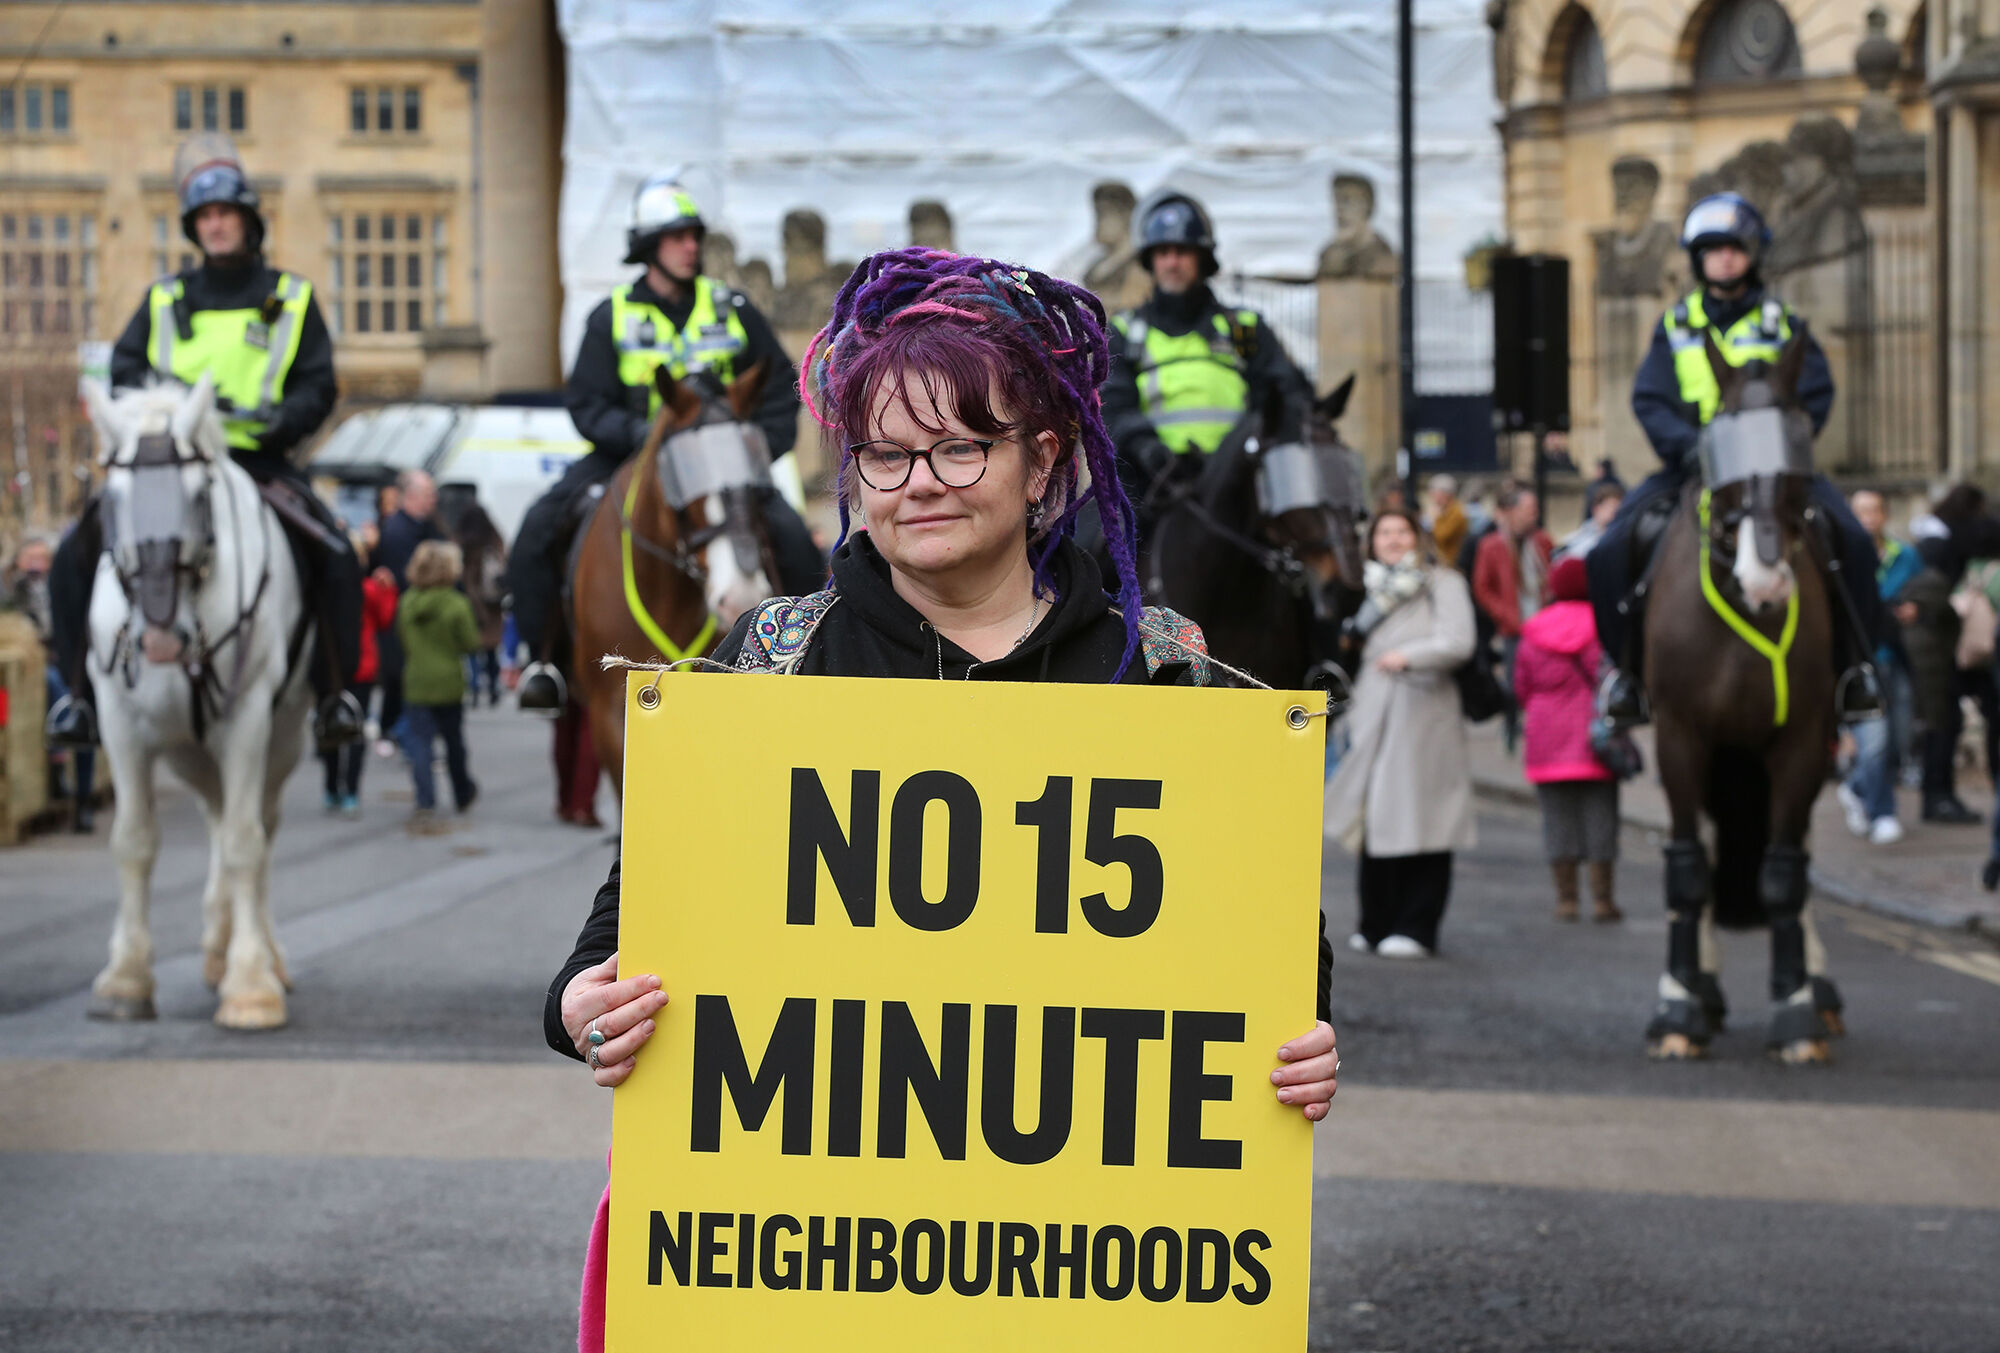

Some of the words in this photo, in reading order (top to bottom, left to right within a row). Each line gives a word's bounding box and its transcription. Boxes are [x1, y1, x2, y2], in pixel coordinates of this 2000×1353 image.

[786, 767, 983, 933] NO
[1014, 775, 1165, 938] 15
[690, 994, 1247, 1170] MINUTE
[647, 1210, 1273, 1306] NEIGHBOURHOODS
